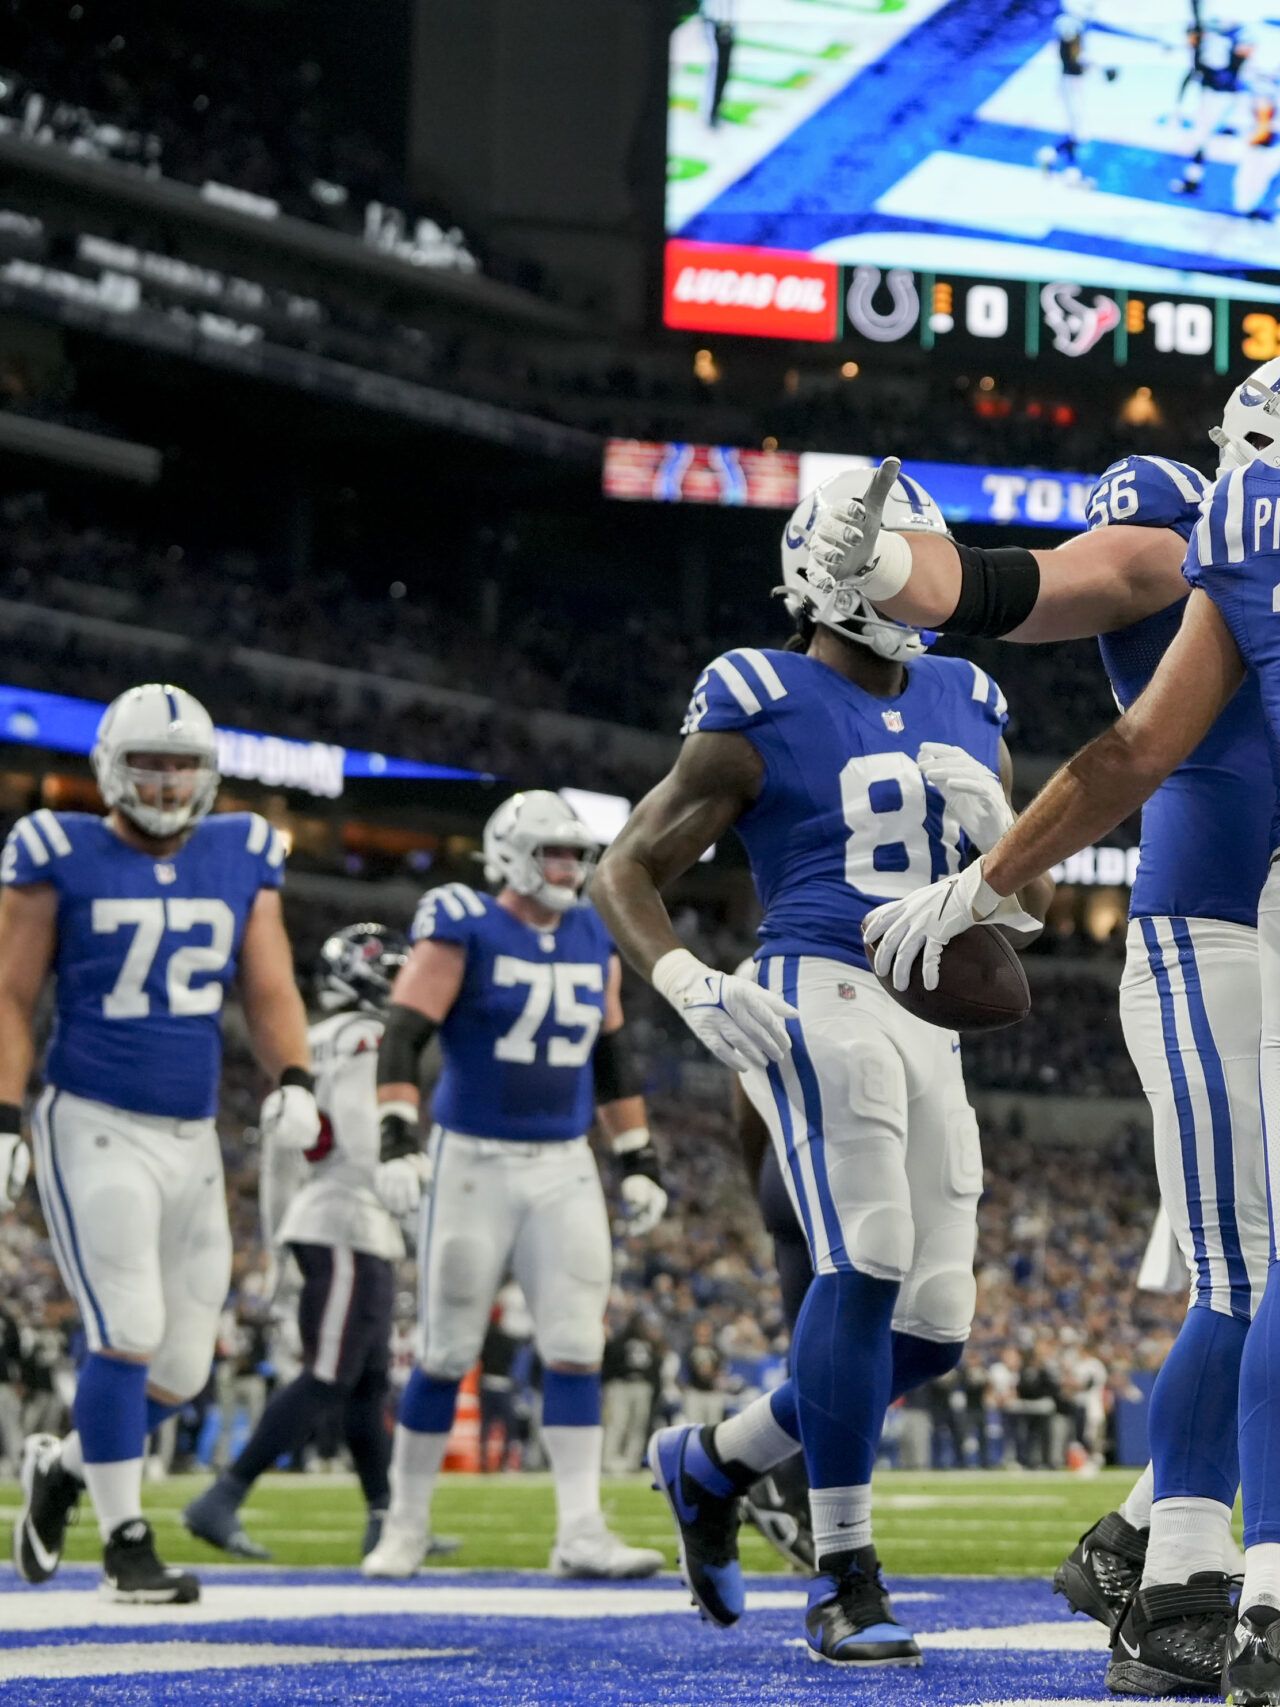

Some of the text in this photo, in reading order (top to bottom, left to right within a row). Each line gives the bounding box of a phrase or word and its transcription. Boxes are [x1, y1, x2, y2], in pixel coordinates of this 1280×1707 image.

[673, 266, 826, 313] LUCAS OIL
[966, 285, 1008, 338] 0
[1147, 301, 1213, 355] 10
[91, 898, 235, 1020] 72
[493, 954, 602, 1067] 75
